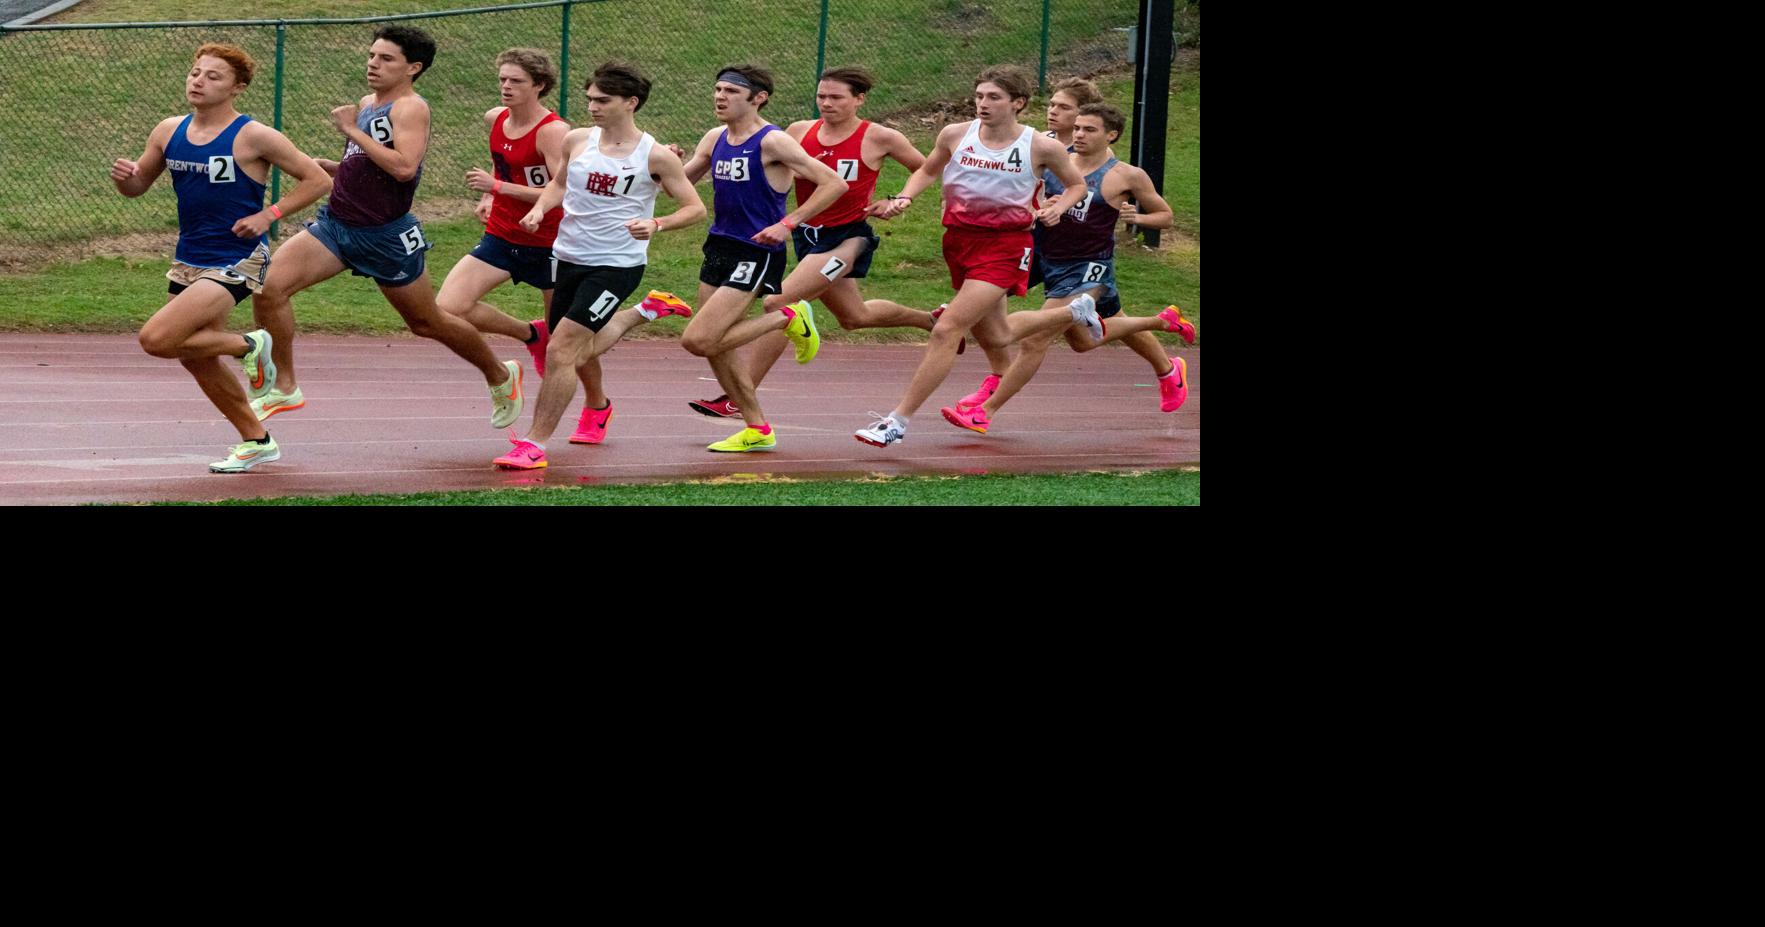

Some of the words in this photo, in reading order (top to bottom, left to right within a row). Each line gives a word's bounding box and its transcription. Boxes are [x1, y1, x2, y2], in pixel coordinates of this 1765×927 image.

[375, 118, 390, 142] 5
[714, 159, 731, 175] CP
[960, 155, 1022, 173] RAVENWO
[1008, 147, 1022, 168] 4
[213, 157, 230, 182] 2
[529, 166, 545, 186] 6
[734, 158, 745, 180] 3
[841, 160, 854, 180] 7
[622, 174, 636, 195] 1
[405, 229, 419, 251] 5
[733, 262, 751, 281] 3
[825, 259, 844, 276] 7
[1087, 264, 1103, 282] 8
[597, 296, 615, 316] 1
[884, 429, 899, 445] AIR
